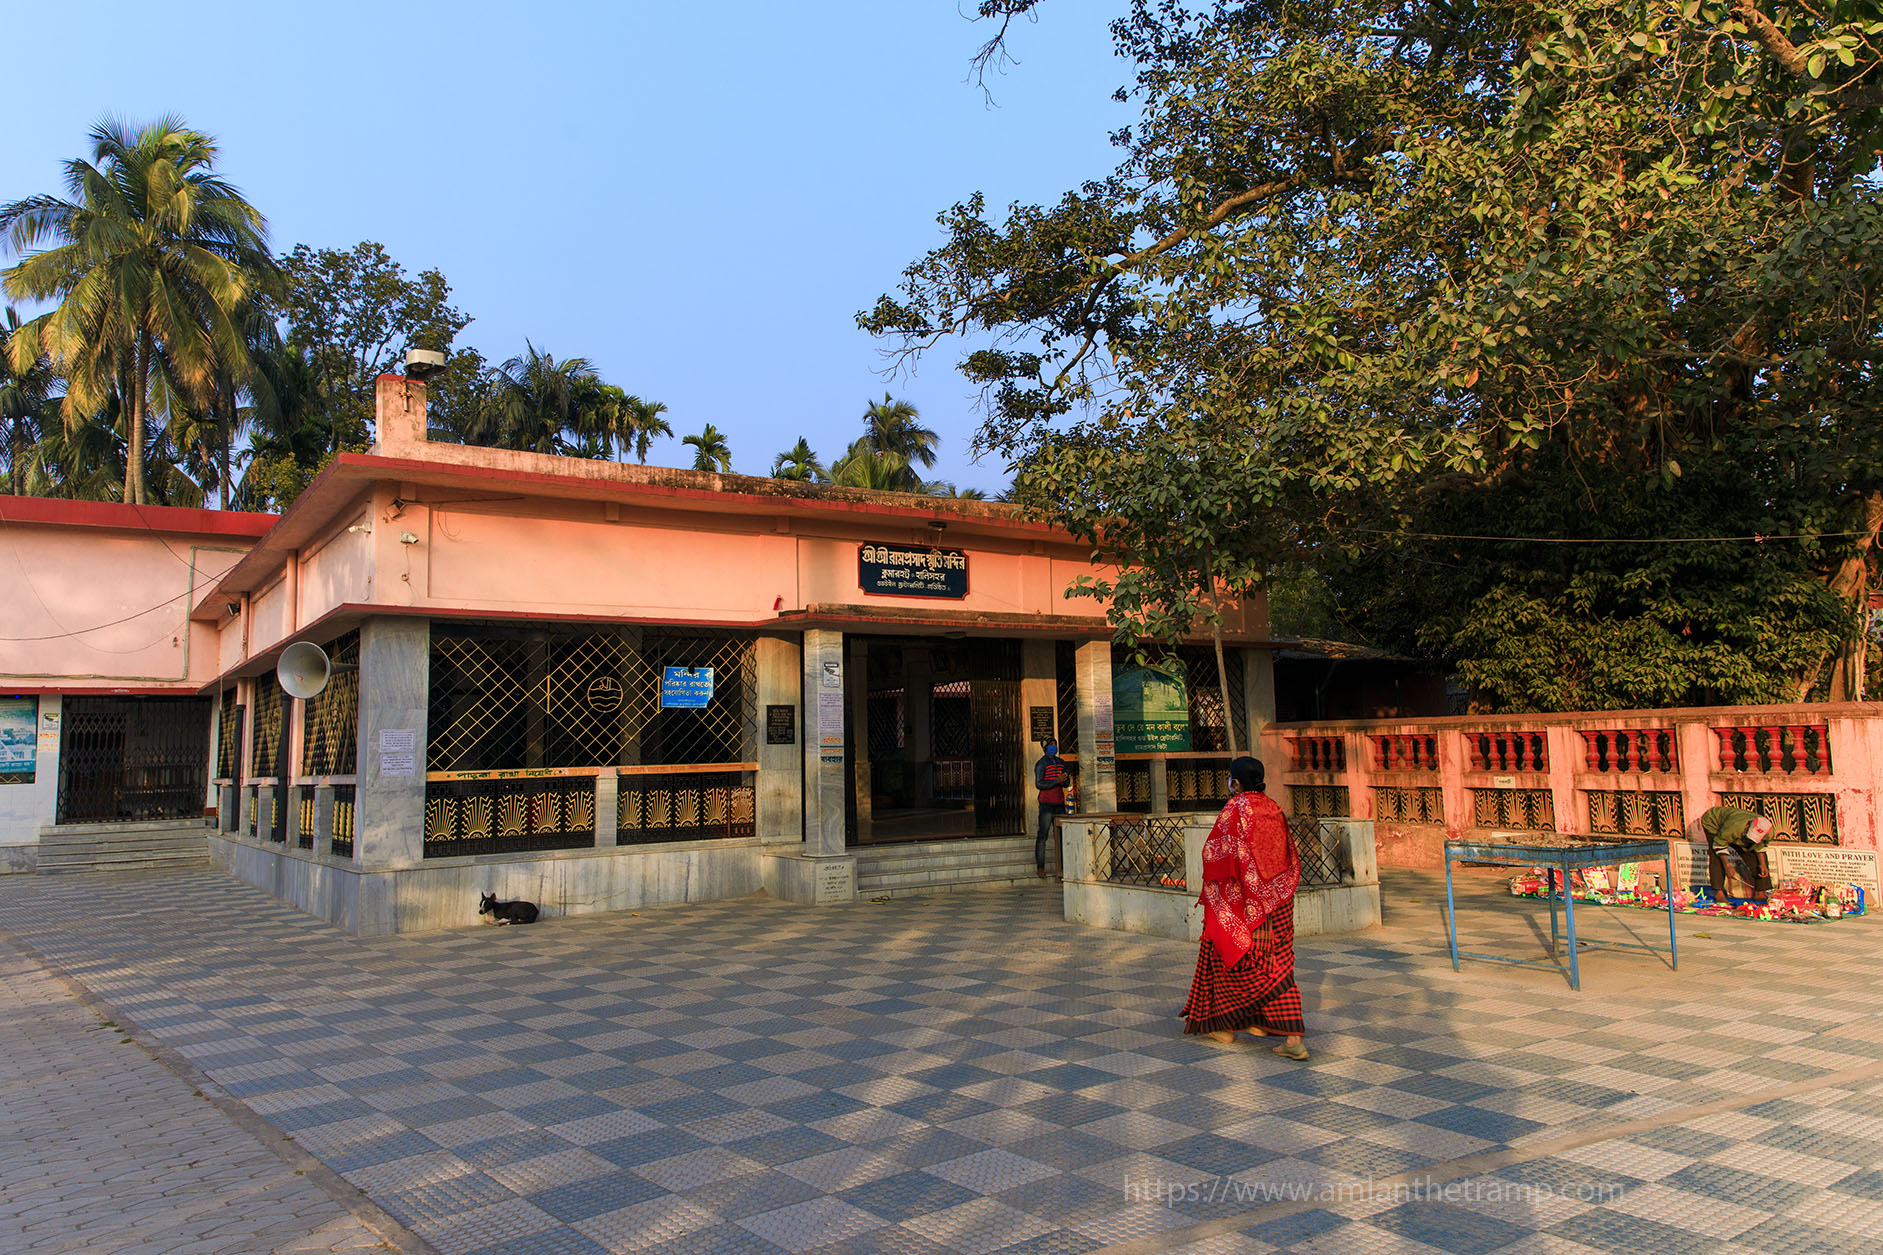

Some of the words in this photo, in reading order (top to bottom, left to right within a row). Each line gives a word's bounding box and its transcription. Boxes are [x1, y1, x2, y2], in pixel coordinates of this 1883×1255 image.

[862, 545, 876, 564] শ্রী
[876, 546, 889, 565] শ্রী
[889, 552, 926, 567] রামপ্রসাদ
[943, 553, 965, 570] মন্দির
[915, 569, 946, 581] হালিসহর
[1146, 723, 1156, 732] মন
[1157, 720, 1172, 731] কালী
[1782, 850, 1801, 858] WITH
[1802, 851, 1823, 859] LOVE
[1841, 854, 1875, 862] PRAYER
